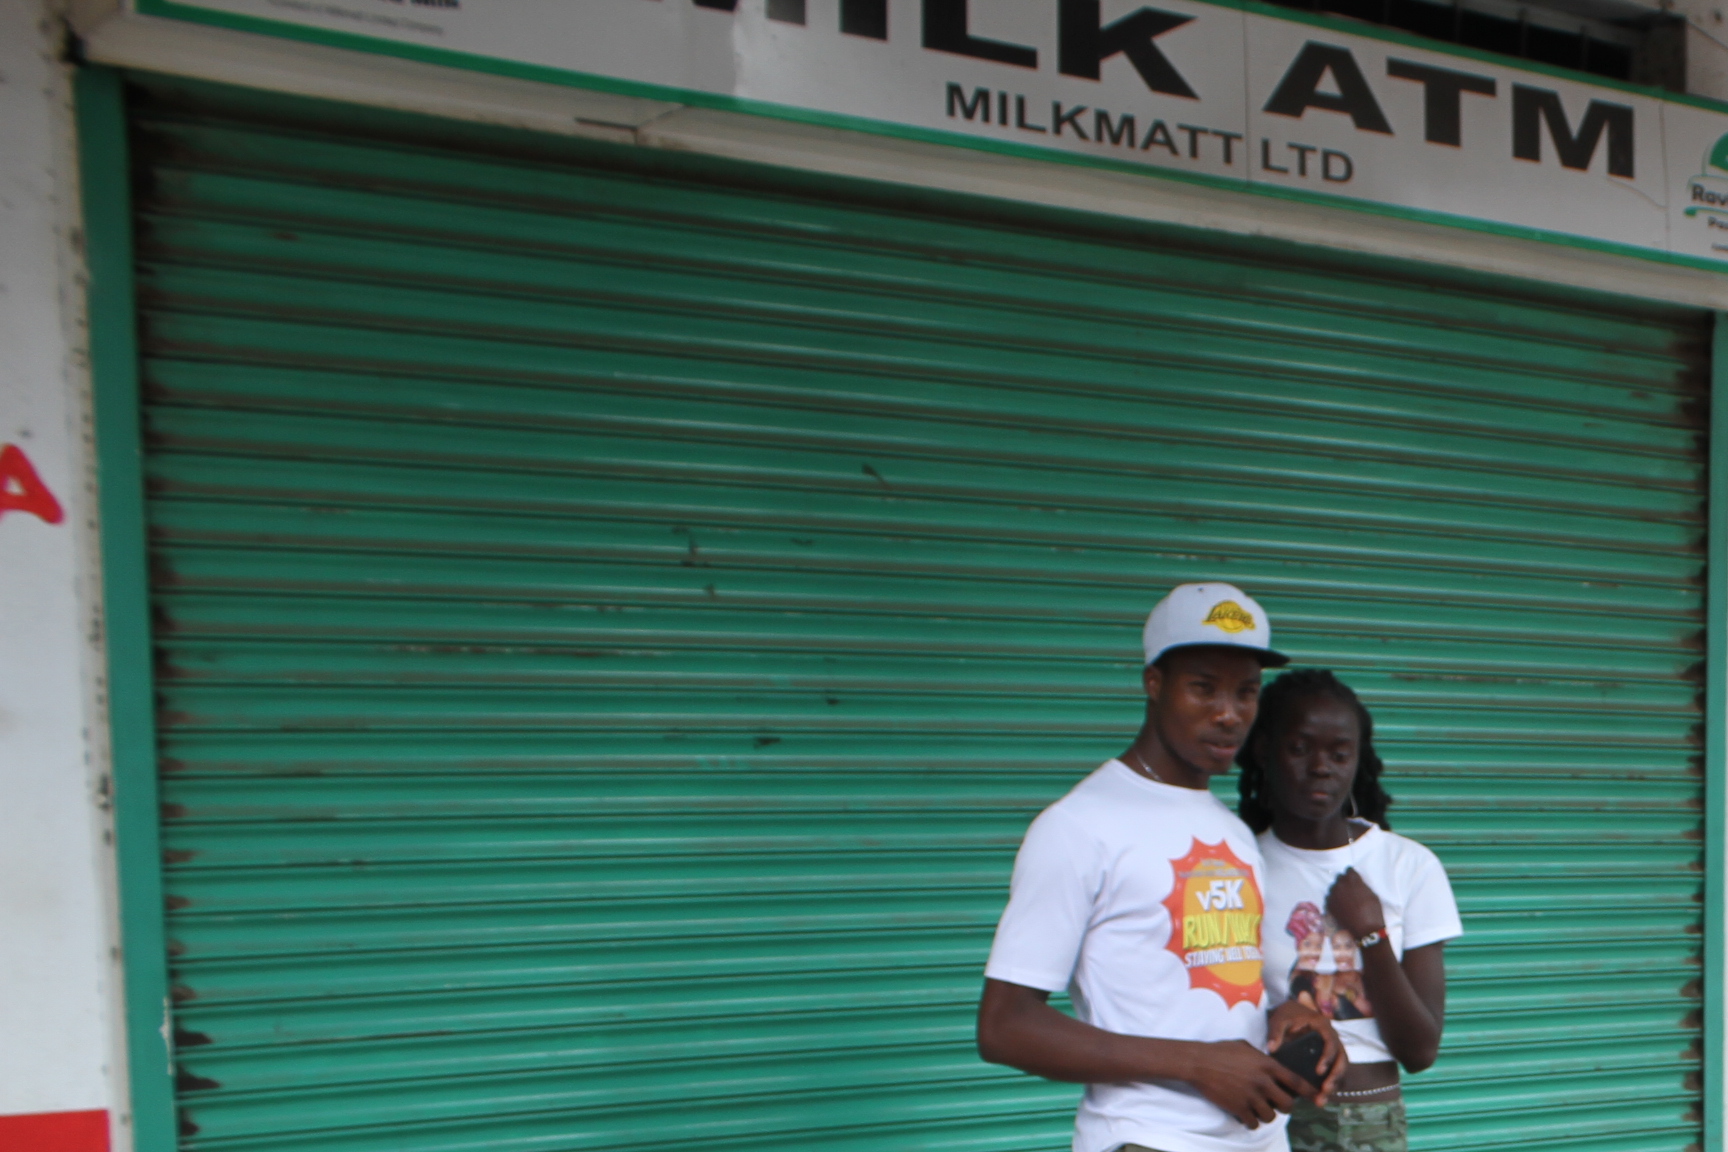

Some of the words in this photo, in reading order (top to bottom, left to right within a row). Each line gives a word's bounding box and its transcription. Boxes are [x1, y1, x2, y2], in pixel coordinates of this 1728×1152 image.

[626, 0, 1200, 100] LK
[1263, 40, 1636, 179] ATM
[945, 81, 1243, 166] MILKMATT
[1261, 138, 1354, 183] LTD
